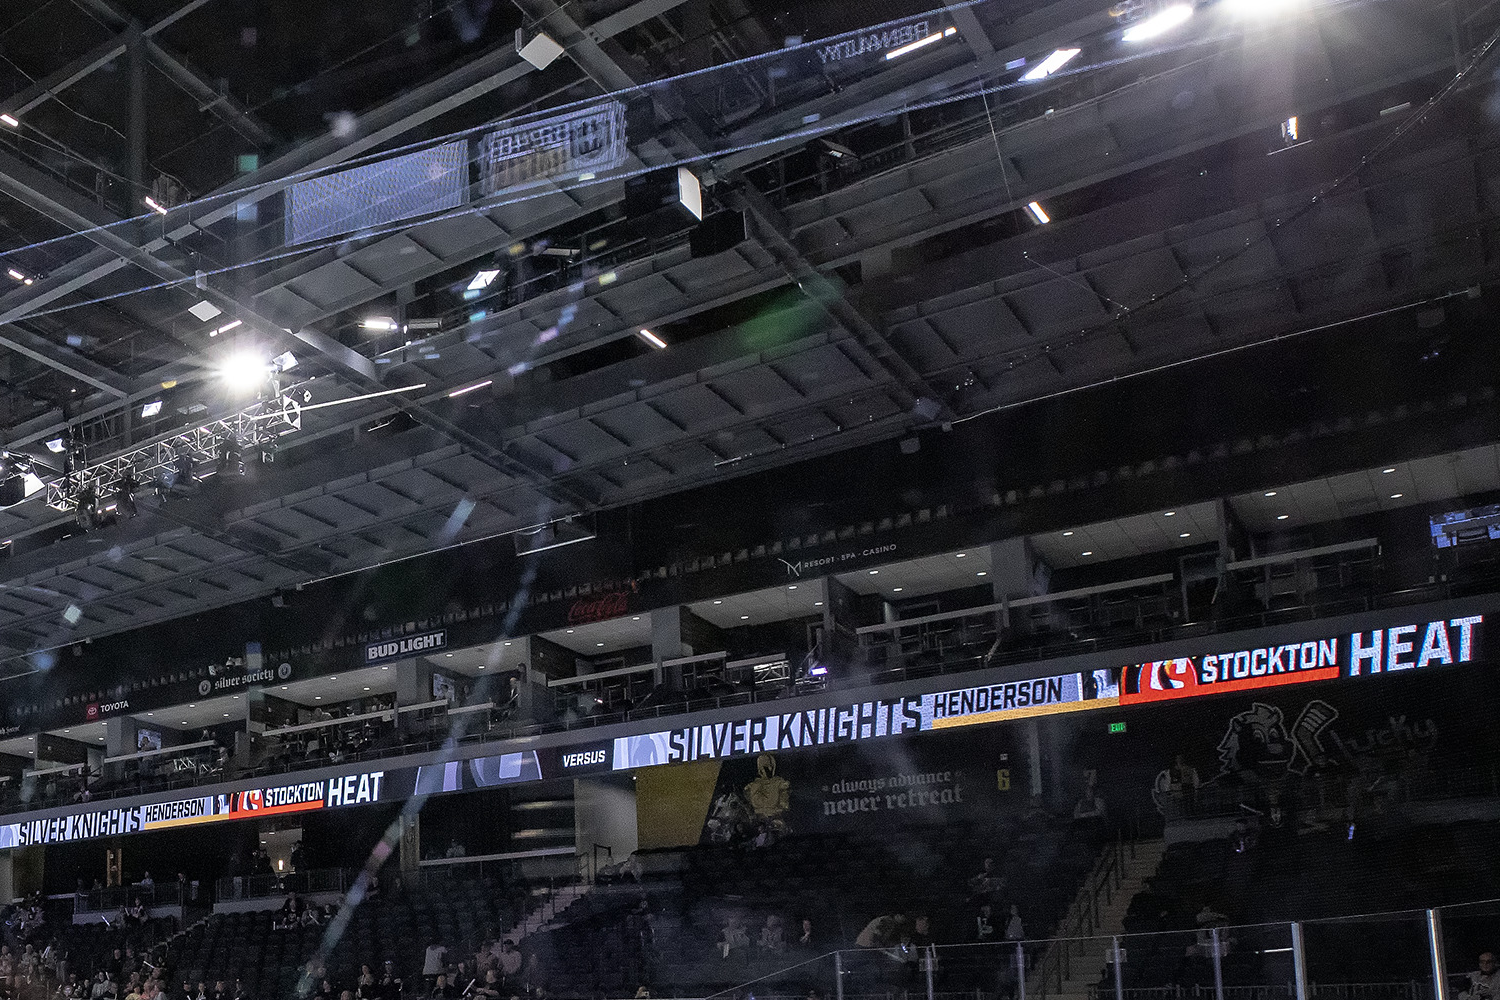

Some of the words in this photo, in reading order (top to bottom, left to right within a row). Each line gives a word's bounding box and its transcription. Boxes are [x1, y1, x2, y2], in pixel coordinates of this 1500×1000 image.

[804, 556, 835, 569] RESORT
[841, 552, 856, 562] SPA
[862, 543, 897, 556] CASINO
[367, 644, 398, 660] BUD
[399, 632, 445, 653] LIGHT
[1201, 638, 1338, 685] STOCKTON
[1349, 615, 1484, 677] HEAT
[214, 676, 241, 691] silver
[241, 668, 275, 685] society
[100, 700, 130, 713] TOYOTA
[668, 717, 769, 764] SILVER
[777, 698, 923, 749] KNIGHTS
[933, 677, 1063, 719] HENDERSON
[562, 749, 606, 768] VERSUS
[145, 798, 205, 822] HENDERSON
[265, 781, 325, 807] STOCKTON
[327, 770, 384, 807] HEAT
[823, 796, 881, 816] never
[886, 783, 963, 808] retreat
